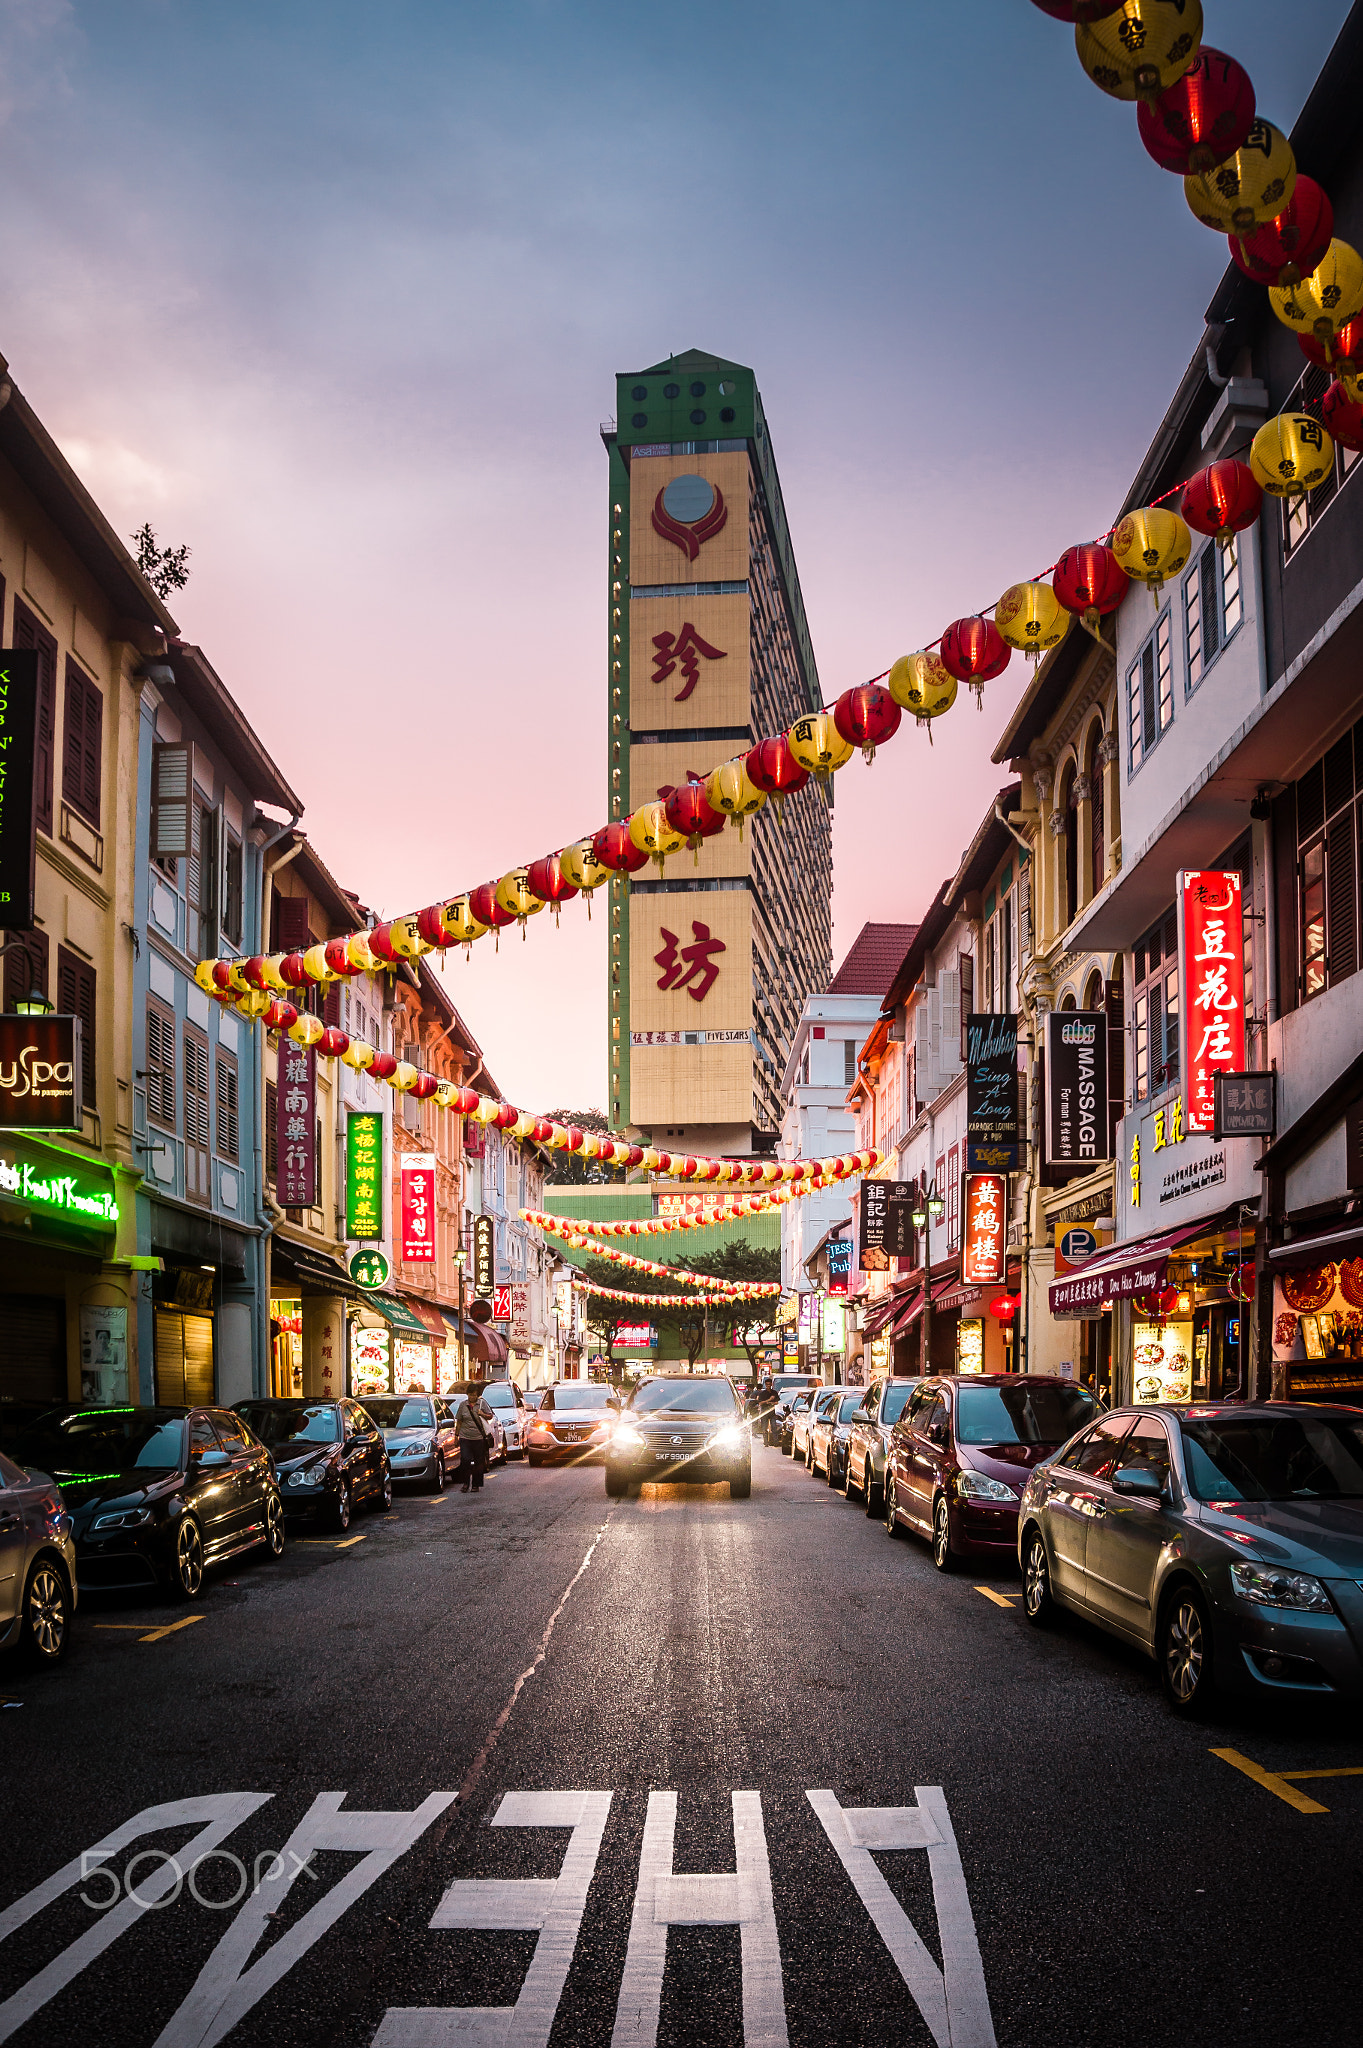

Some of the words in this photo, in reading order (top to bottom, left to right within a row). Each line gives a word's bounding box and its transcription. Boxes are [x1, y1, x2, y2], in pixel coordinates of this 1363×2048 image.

[651, 621, 728, 702] 珍
[654, 919, 727, 1002] 坊
[1194, 919, 1238, 1063] 豆花庄
[707, 1033, 725, 1041] FIVE
[725, 1031, 749, 1041] STARS
[973, 1067, 1012, 1087] Sing
[41, 1088, 73, 1098] pampered
[1060, 1088, 1071, 1101] For
[1078, 1048, 1096, 1157] MASSAGE
[972, 1100, 1012, 1120] Long
[1060, 1103, 1069, 1119] man
[968, 1122, 995, 1131] KARAOKE
[995, 1122, 1017, 1131] LOUNGE
[991, 1132, 1003, 1142] PUB
[353, 1115, 377, 1217] 老杨记湖南菜
[974, 1148, 1012, 1166] Tiger
[1130, 1134, 1140, 1208] 老四川
[409, 1174, 427, 1237] 금강원
[970, 1180, 1000, 1261] 黄鹤楼
[1068, 1231, 1090, 1256] P
[831, 1259, 852, 1274] Pub
[974, 1263, 995, 1271] Chinese
[1109, 1278, 1120, 1294] Dou
[1121, 1274, 1133, 1291] Hua
[1134, 1270, 1157, 1289] Zhuang
